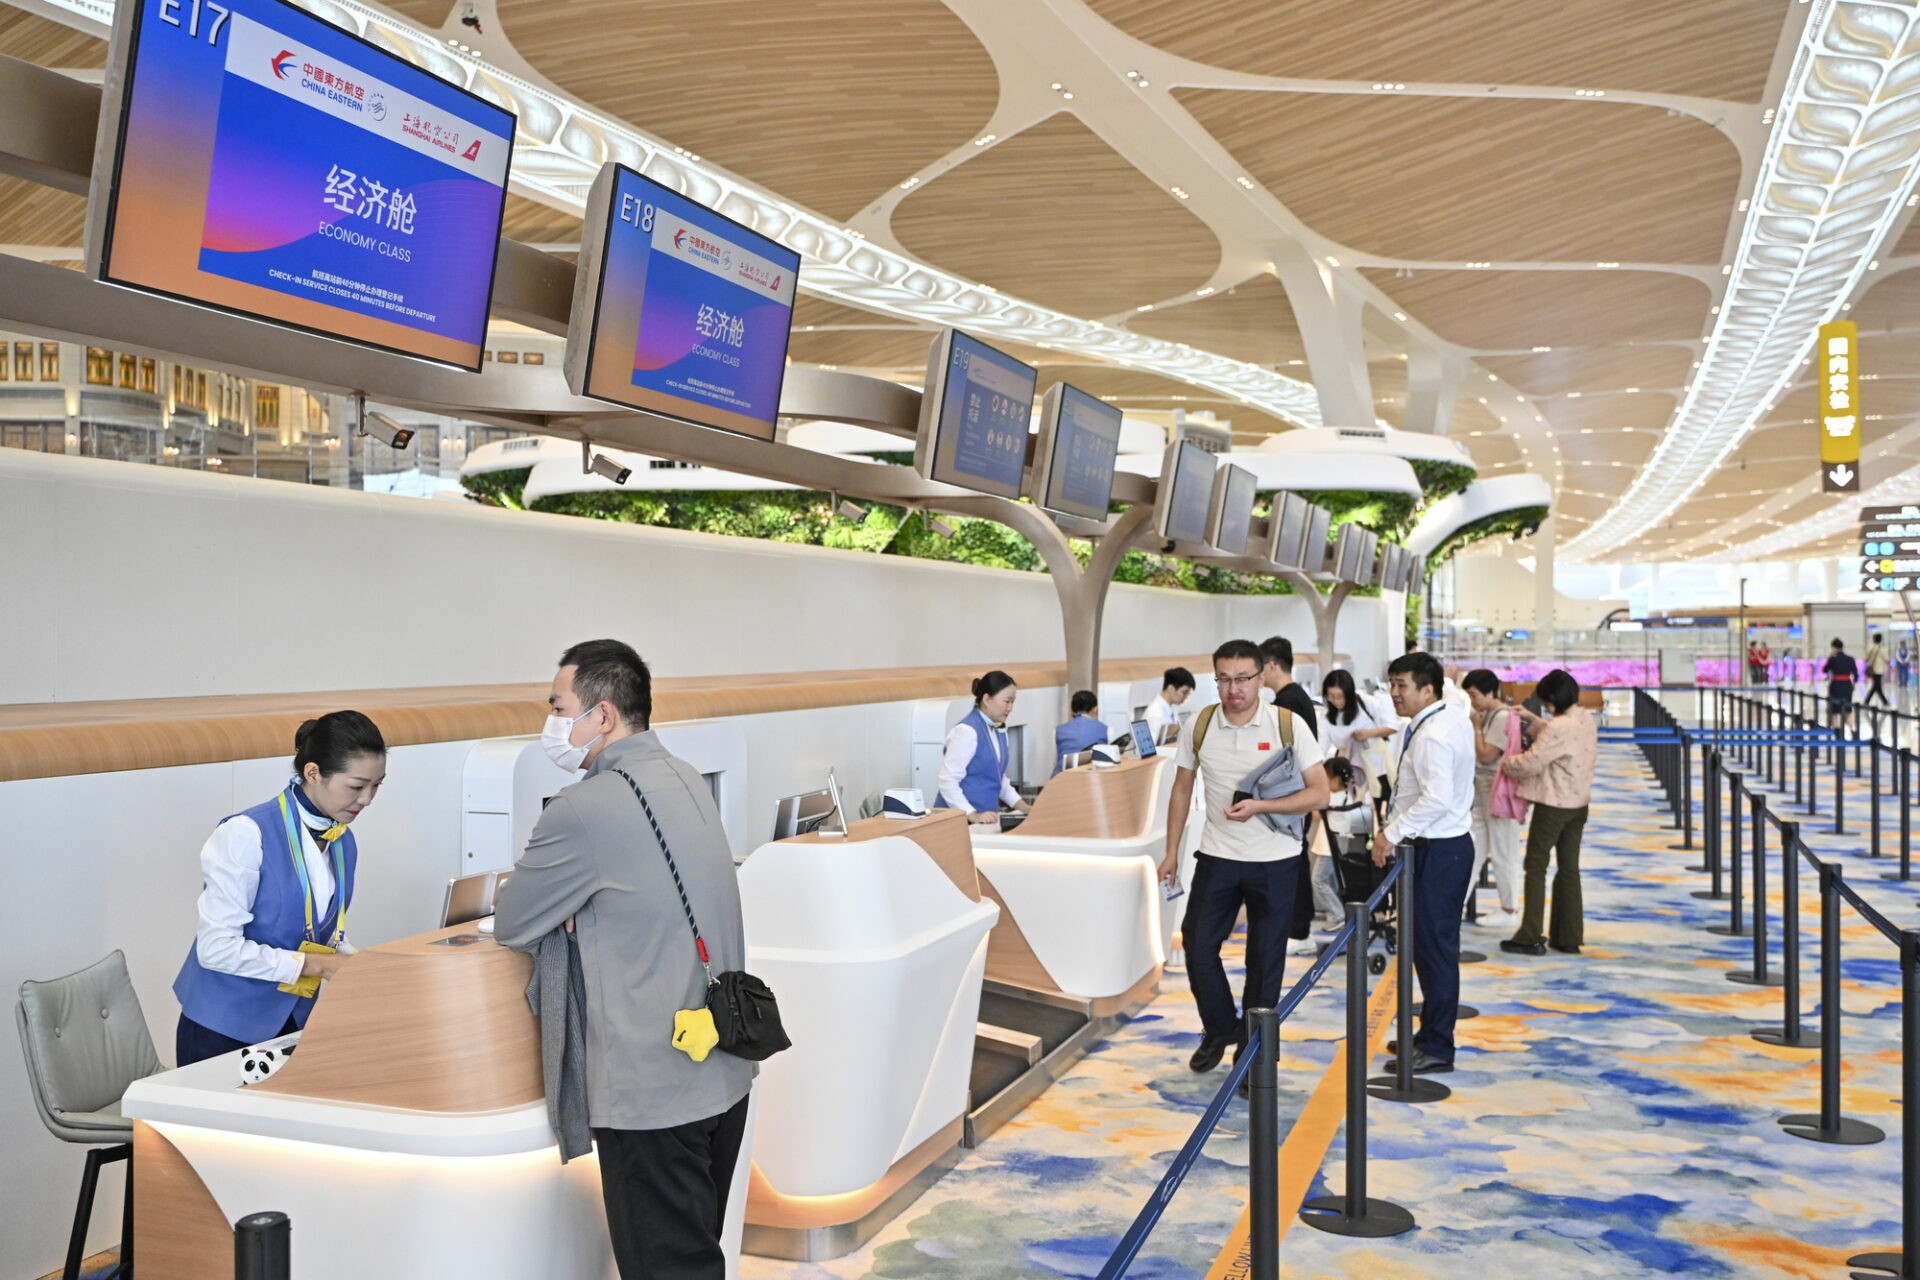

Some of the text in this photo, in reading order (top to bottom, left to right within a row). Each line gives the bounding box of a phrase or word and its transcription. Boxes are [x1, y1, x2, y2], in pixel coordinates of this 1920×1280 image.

[159, 0, 229, 46] E17
[301, 78, 363, 112] CHINA EASTERN
[303, 63, 365, 101] 中國東方航空
[402, 124, 431, 142] SHANGHAI
[323, 163, 417, 235] 经济舱
[621, 192, 654, 233] E18
[318, 220, 412, 263] ECONOMY CLASS
[268, 268, 436, 323] CHECK-IN SERVICE CLOSES 40 MINUTES BEFORE DEPARTURE
[695, 303, 745, 348] 经济舱
[691, 343, 740, 368] ECONOMY CLASS
[953, 346, 969, 371] E19
